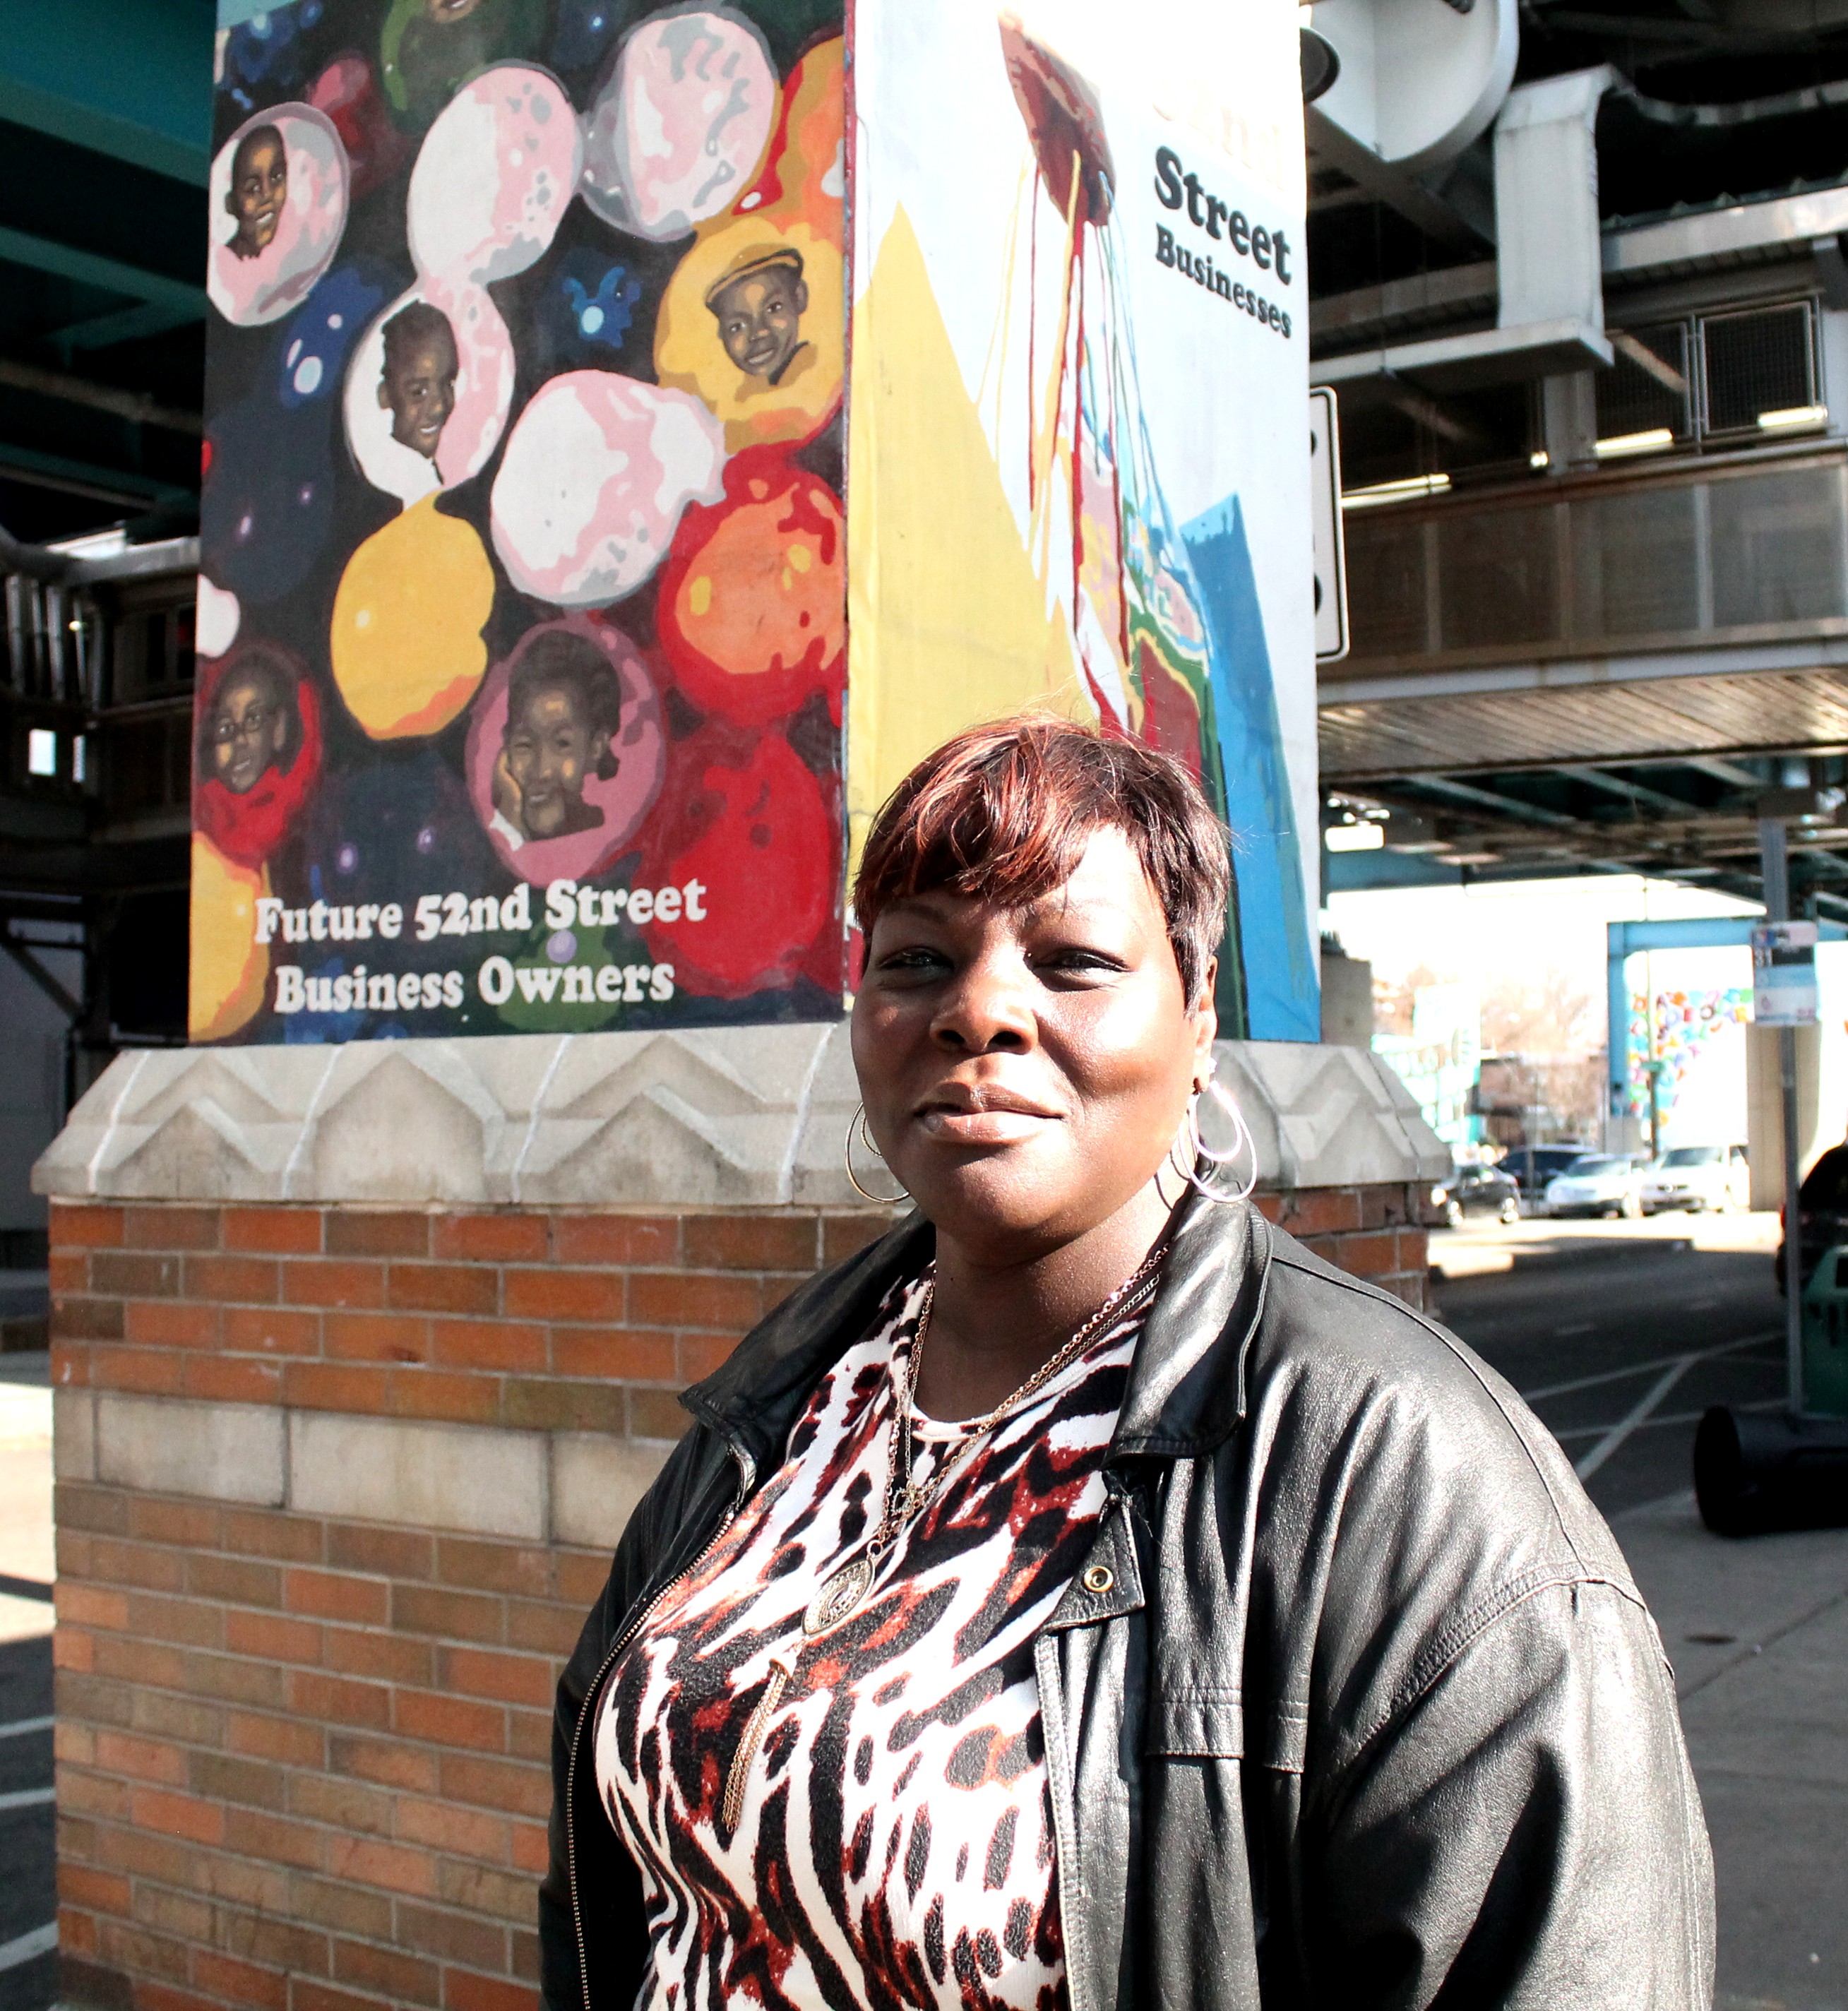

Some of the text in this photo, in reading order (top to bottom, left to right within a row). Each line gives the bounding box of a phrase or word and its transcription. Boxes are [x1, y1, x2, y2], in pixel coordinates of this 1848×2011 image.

[1155, 145, 1292, 285] Street
[1155, 222, 1291, 339] Businesses
[255, 878, 707, 943] Future 52nd Street
[275, 955, 675, 1013] Business Owners
